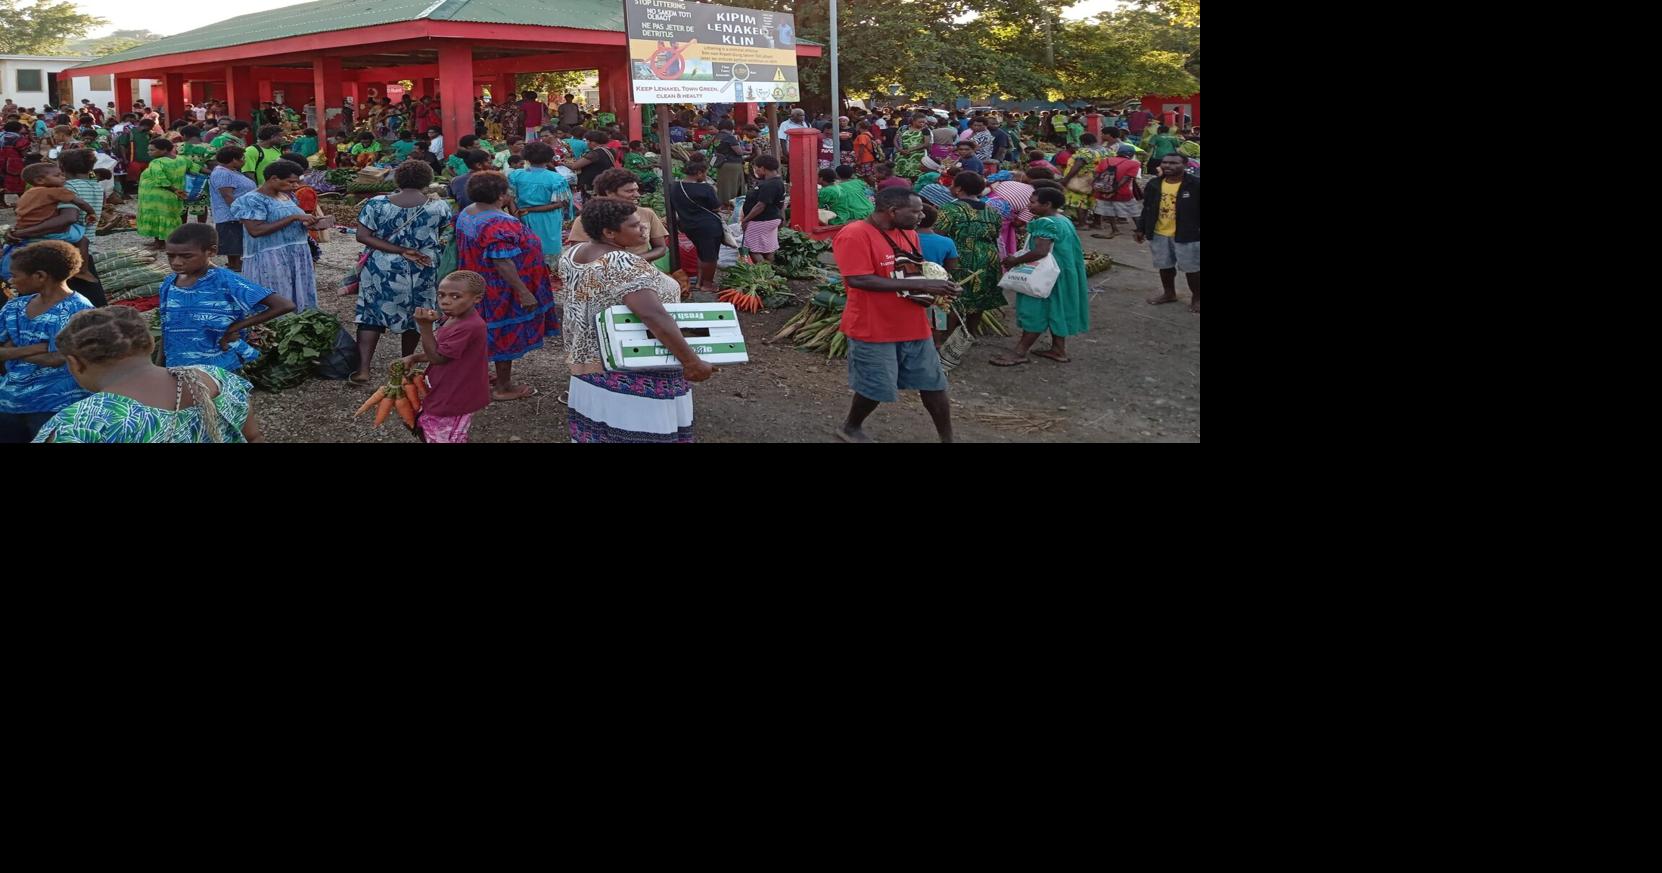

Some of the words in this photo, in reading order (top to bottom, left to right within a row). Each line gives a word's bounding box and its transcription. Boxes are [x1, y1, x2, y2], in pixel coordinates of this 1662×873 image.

[653, 1, 686, 9] LITTERING
[716, 12, 756, 25] KIPIM
[666, 24, 685, 32] JETER
[642, 30, 674, 38] DETRITUS
[722, 34, 754, 46] KLIN
